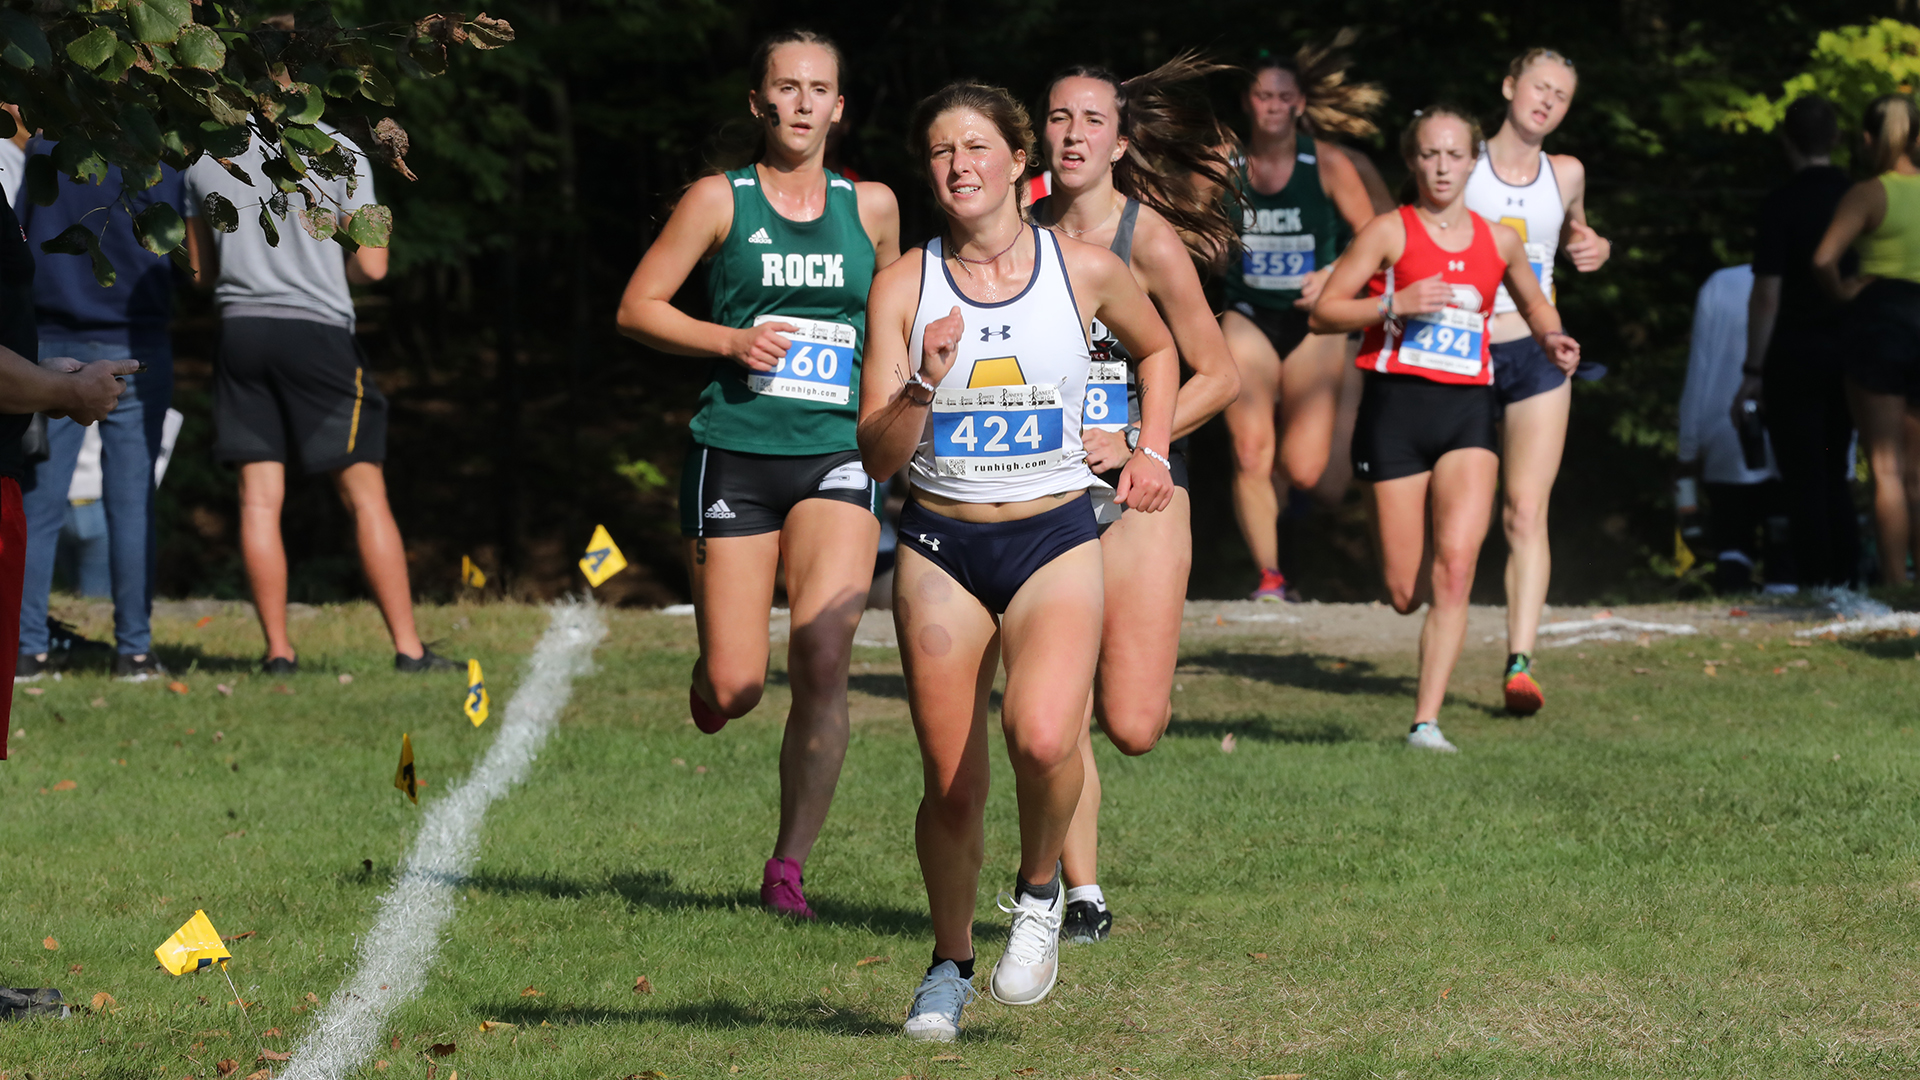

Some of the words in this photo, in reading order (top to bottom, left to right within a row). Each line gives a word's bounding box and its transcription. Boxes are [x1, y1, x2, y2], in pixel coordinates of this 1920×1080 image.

[761, 253, 844, 287] ROCK
[1251, 253, 1304, 275] 559
[1414, 324, 1471, 357] 494
[781, 385, 837, 397] runhigh.com
[950, 414, 1042, 452] 424
[974, 459, 1047, 473] runhigh.com
[585, 547, 611, 572] A
